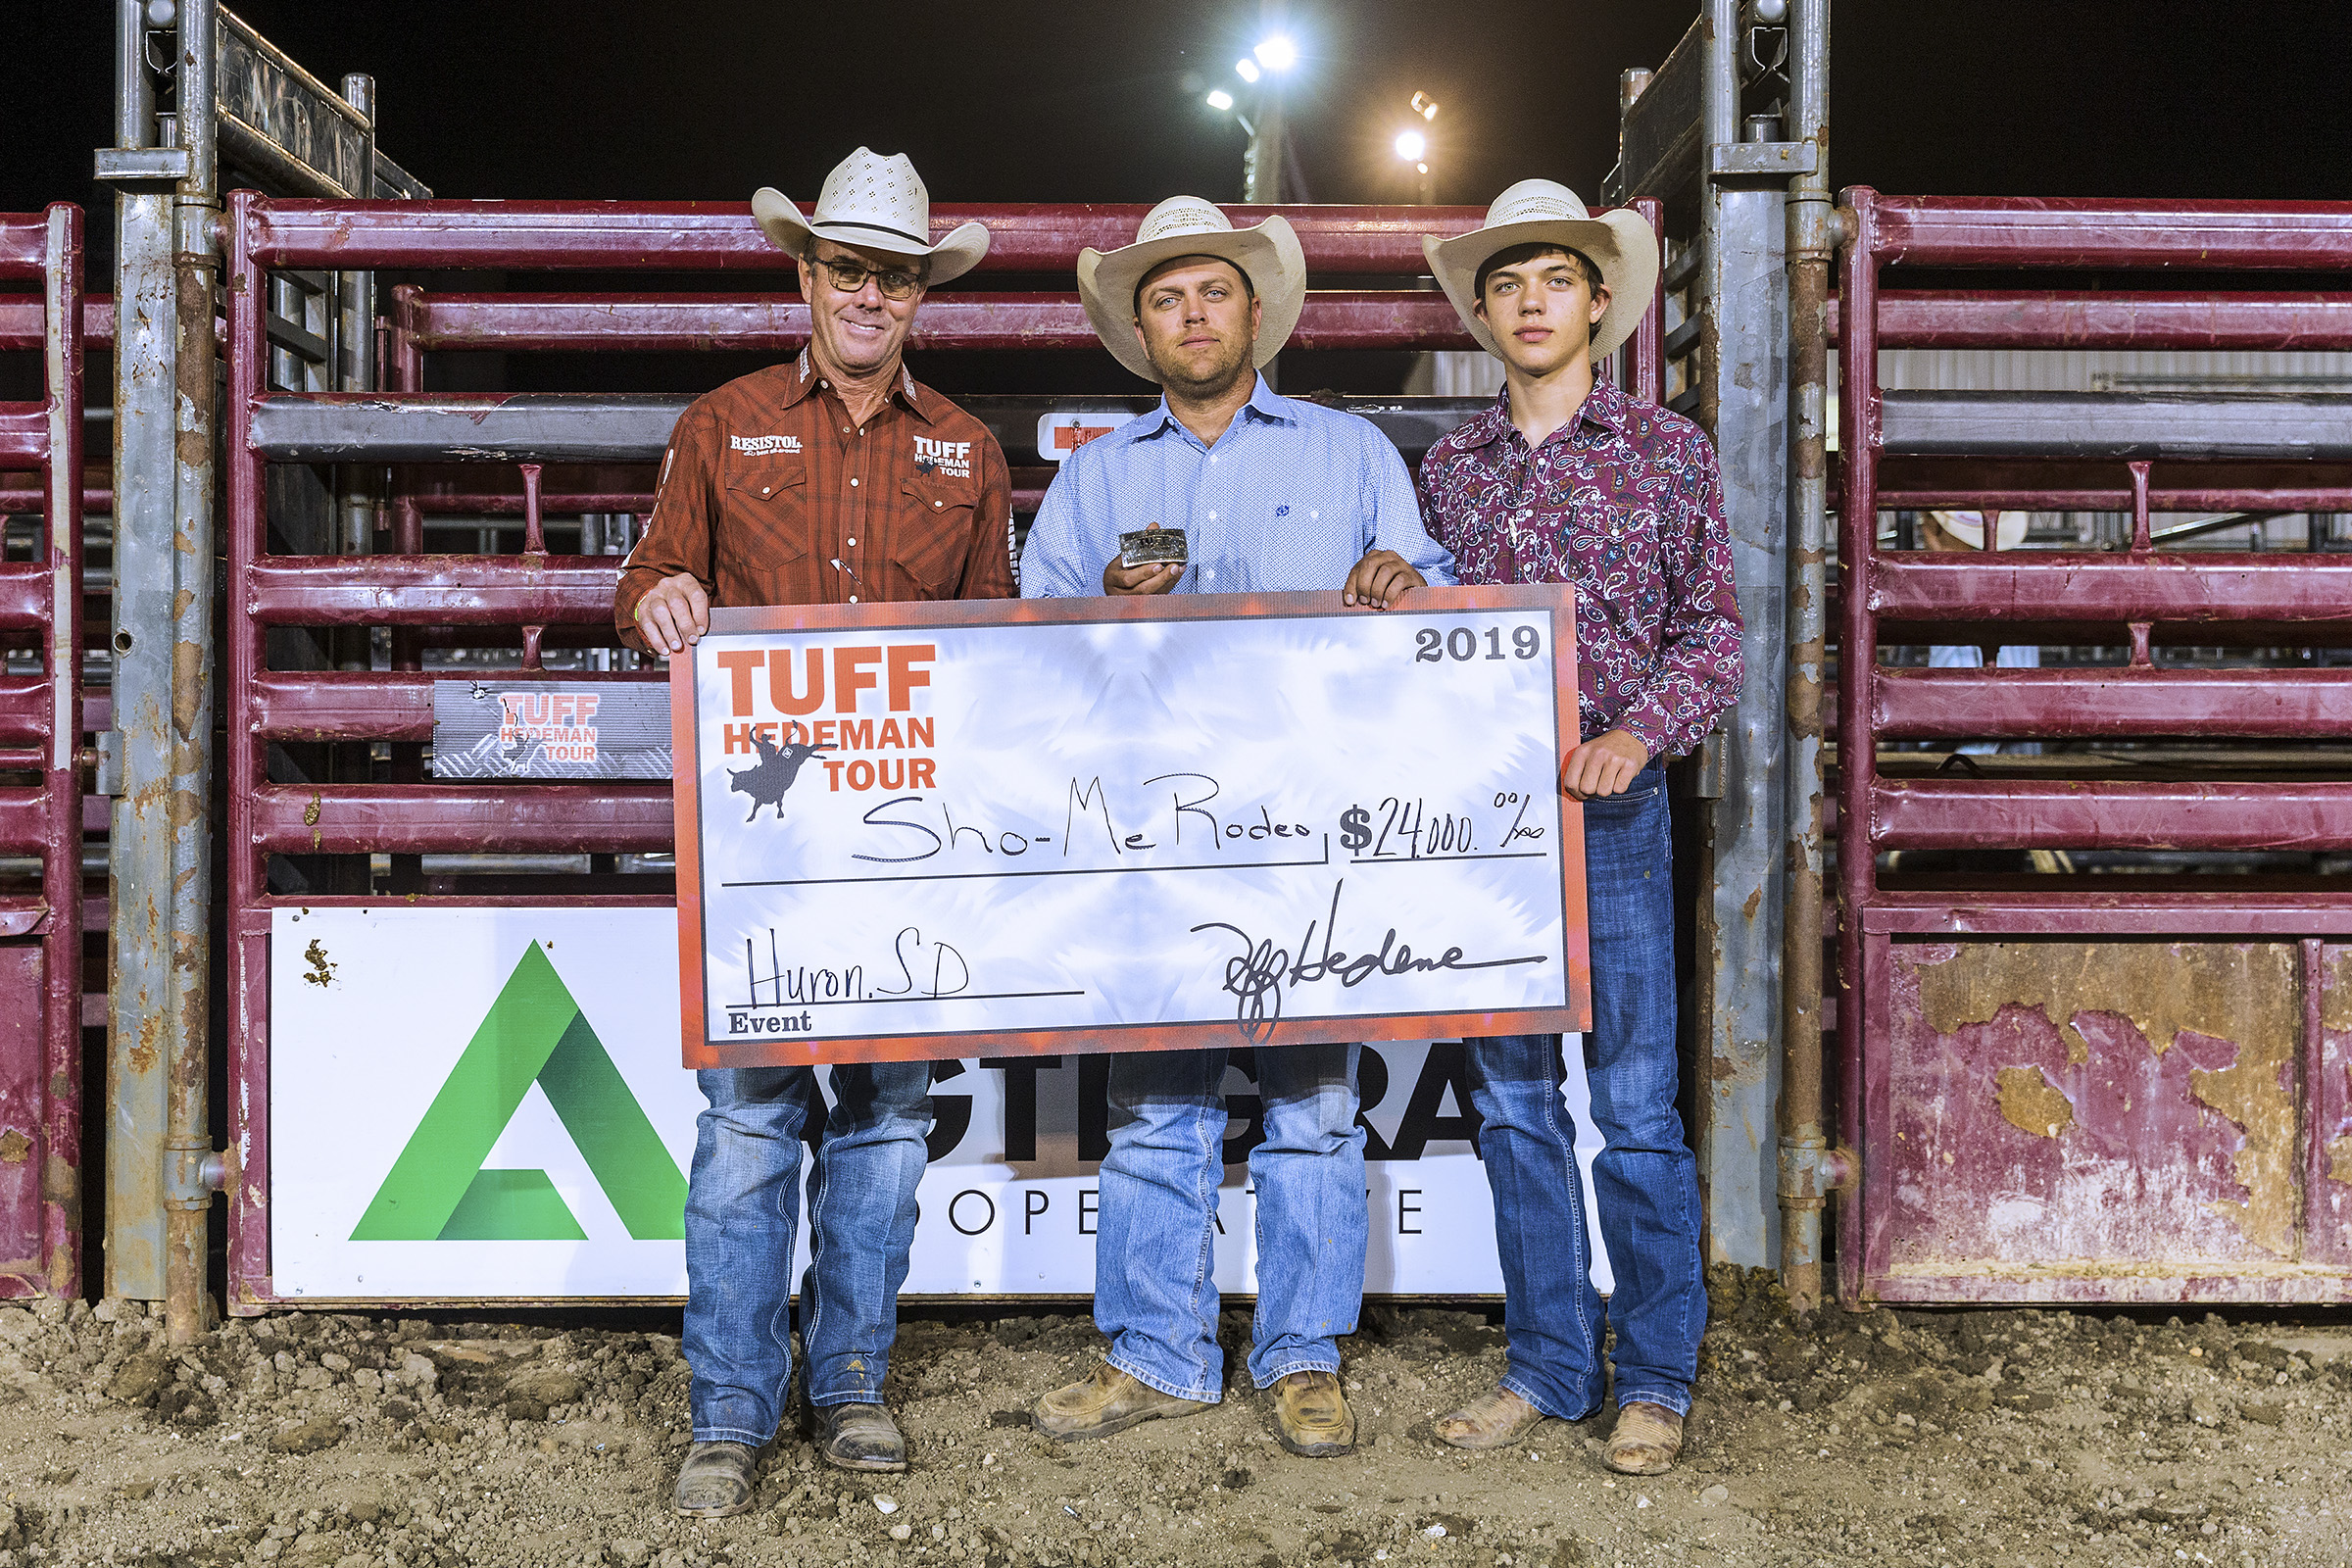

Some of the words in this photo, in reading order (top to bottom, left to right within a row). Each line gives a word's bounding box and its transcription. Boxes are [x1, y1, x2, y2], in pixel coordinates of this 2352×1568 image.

[730, 435, 803, 451] RESISTOL
[913, 435, 970, 459] TUFF
[940, 466, 970, 478] TOUR
[1415, 625, 1541, 662] 2019
[717, 644, 937, 717] TUFF
[500, 695, 599, 725] TUFF
[723, 717, 935, 755] HEDEMAN
[546, 746, 596, 761] TOUR
[822, 758, 937, 792] TOUR
[1144, 772, 1311, 851] Rodeo
[728, 1010, 812, 1034] Event
